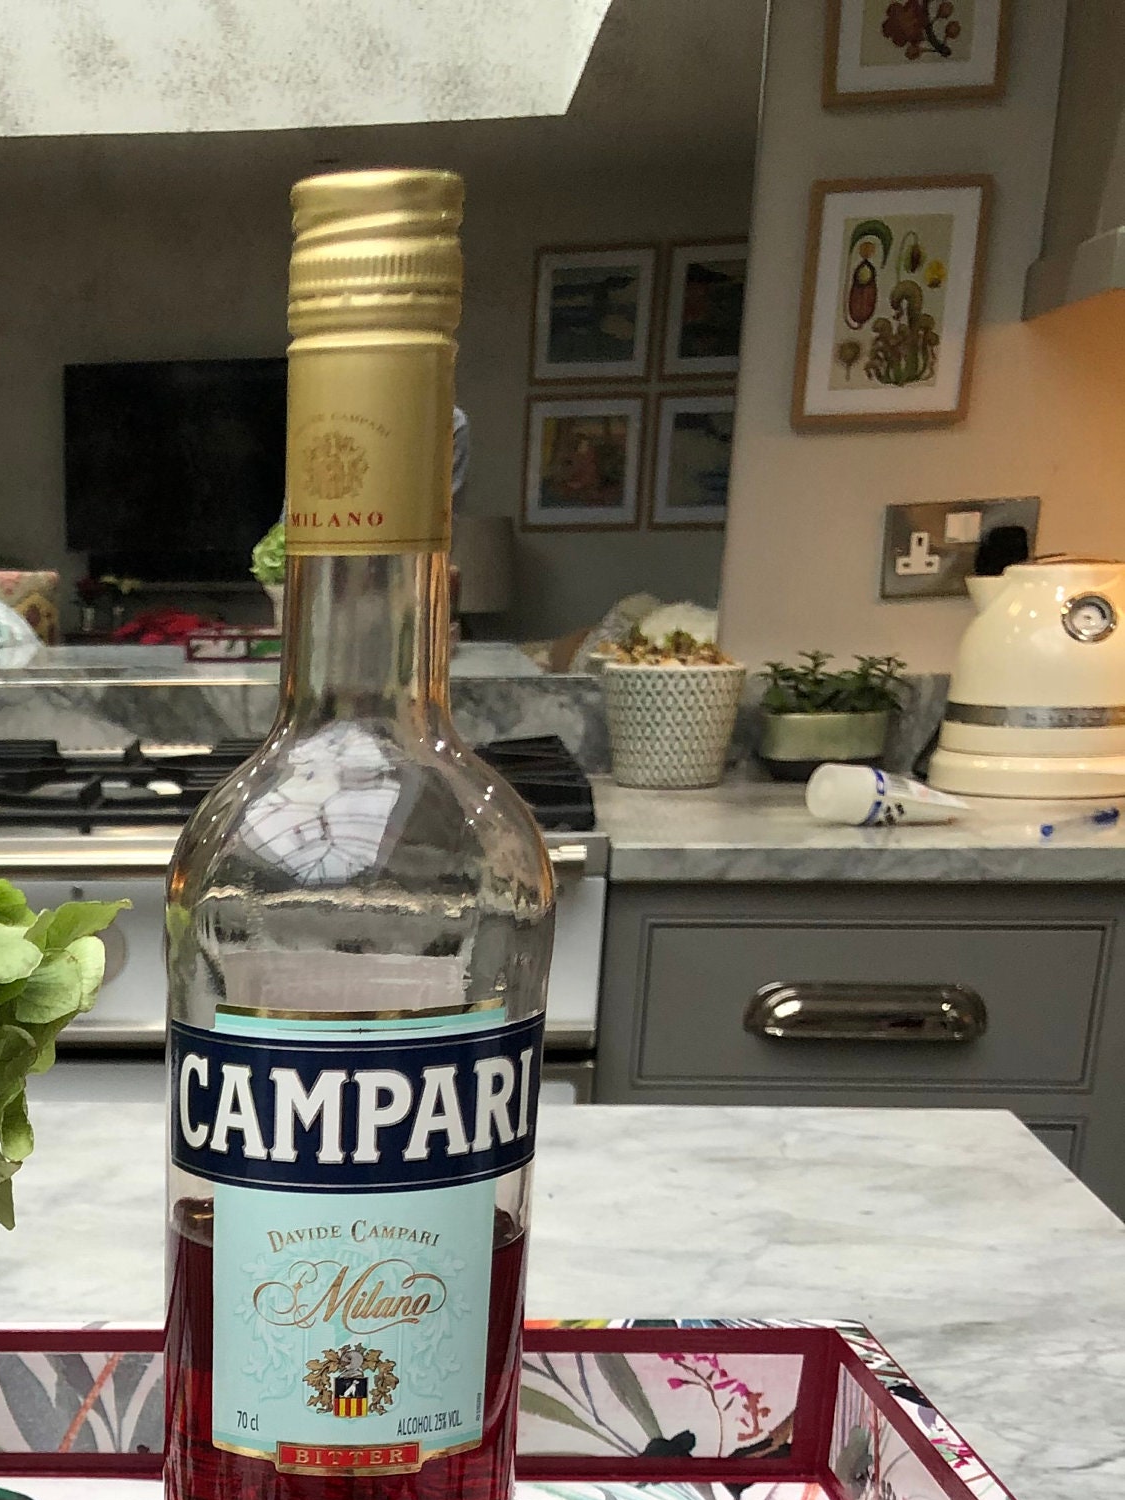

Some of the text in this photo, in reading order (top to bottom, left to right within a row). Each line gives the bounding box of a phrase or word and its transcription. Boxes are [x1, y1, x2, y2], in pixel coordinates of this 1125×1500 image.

[290, 511, 385, 528] MILANO
[179, 1049, 535, 1164] CAMPARI
[267, 1219, 441, 1254] DAVIDE CAMPARI
[253, 1258, 447, 1335] Milano
[236, 1411, 260, 1432] 70 cl
[397, 1410, 463, 1436] ALCOHOL 25% VOL.
[295, 1450, 404, 1466] BITTER
